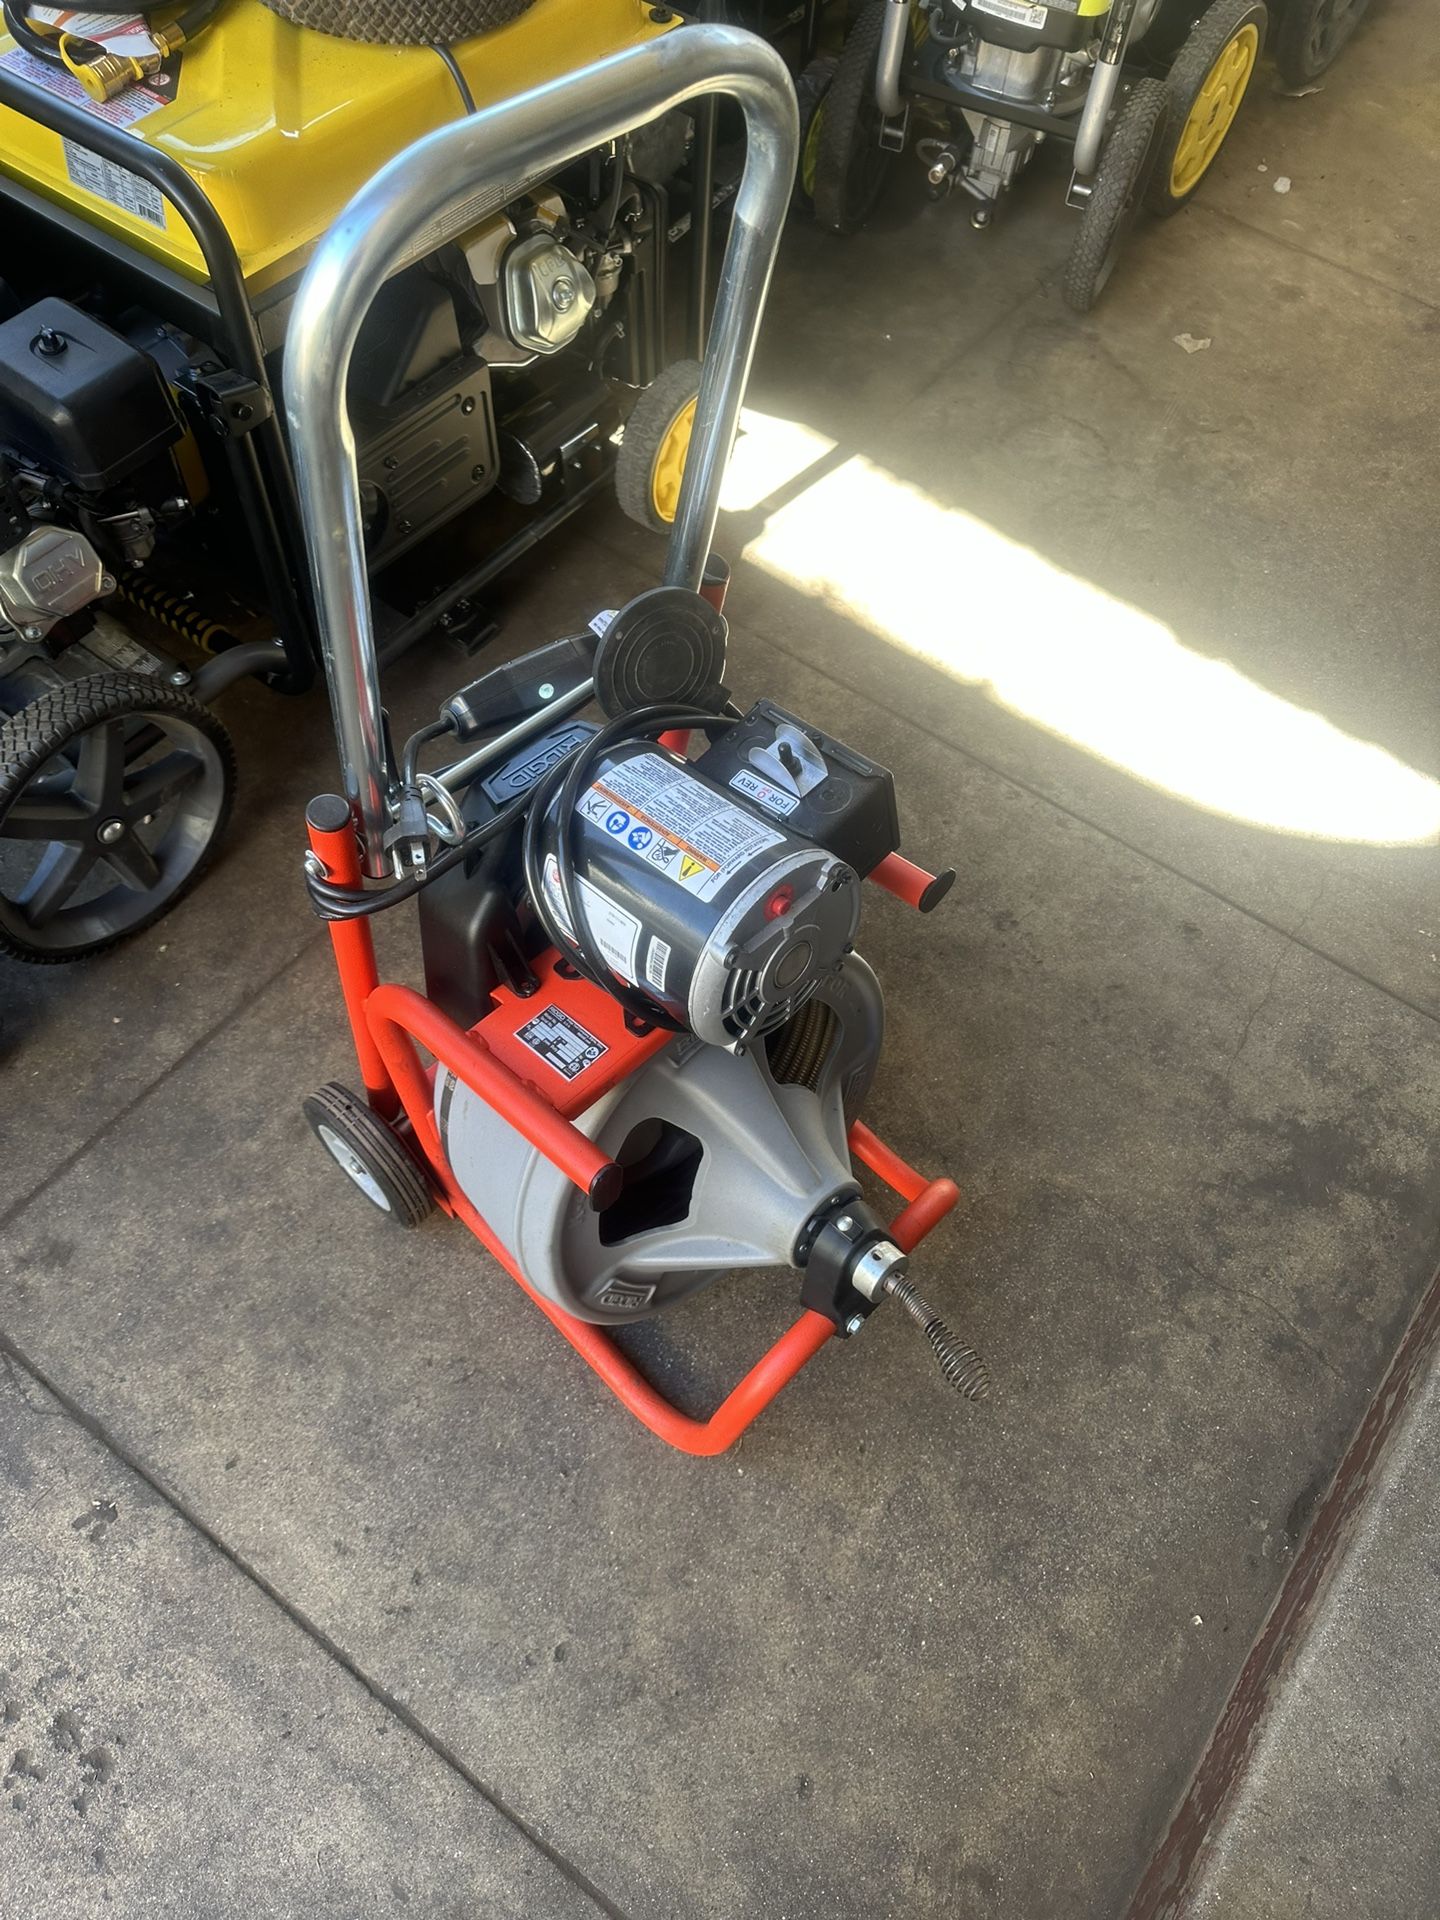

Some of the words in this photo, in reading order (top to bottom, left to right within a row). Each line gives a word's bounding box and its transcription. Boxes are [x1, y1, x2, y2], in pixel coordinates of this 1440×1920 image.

[32, 547, 85, 591] OHV
[509, 736, 581, 788] RIDGID
[738, 777, 759, 792] REV
[768, 794, 790, 810] FOR
[600, 1293, 643, 1309] RIDGID
